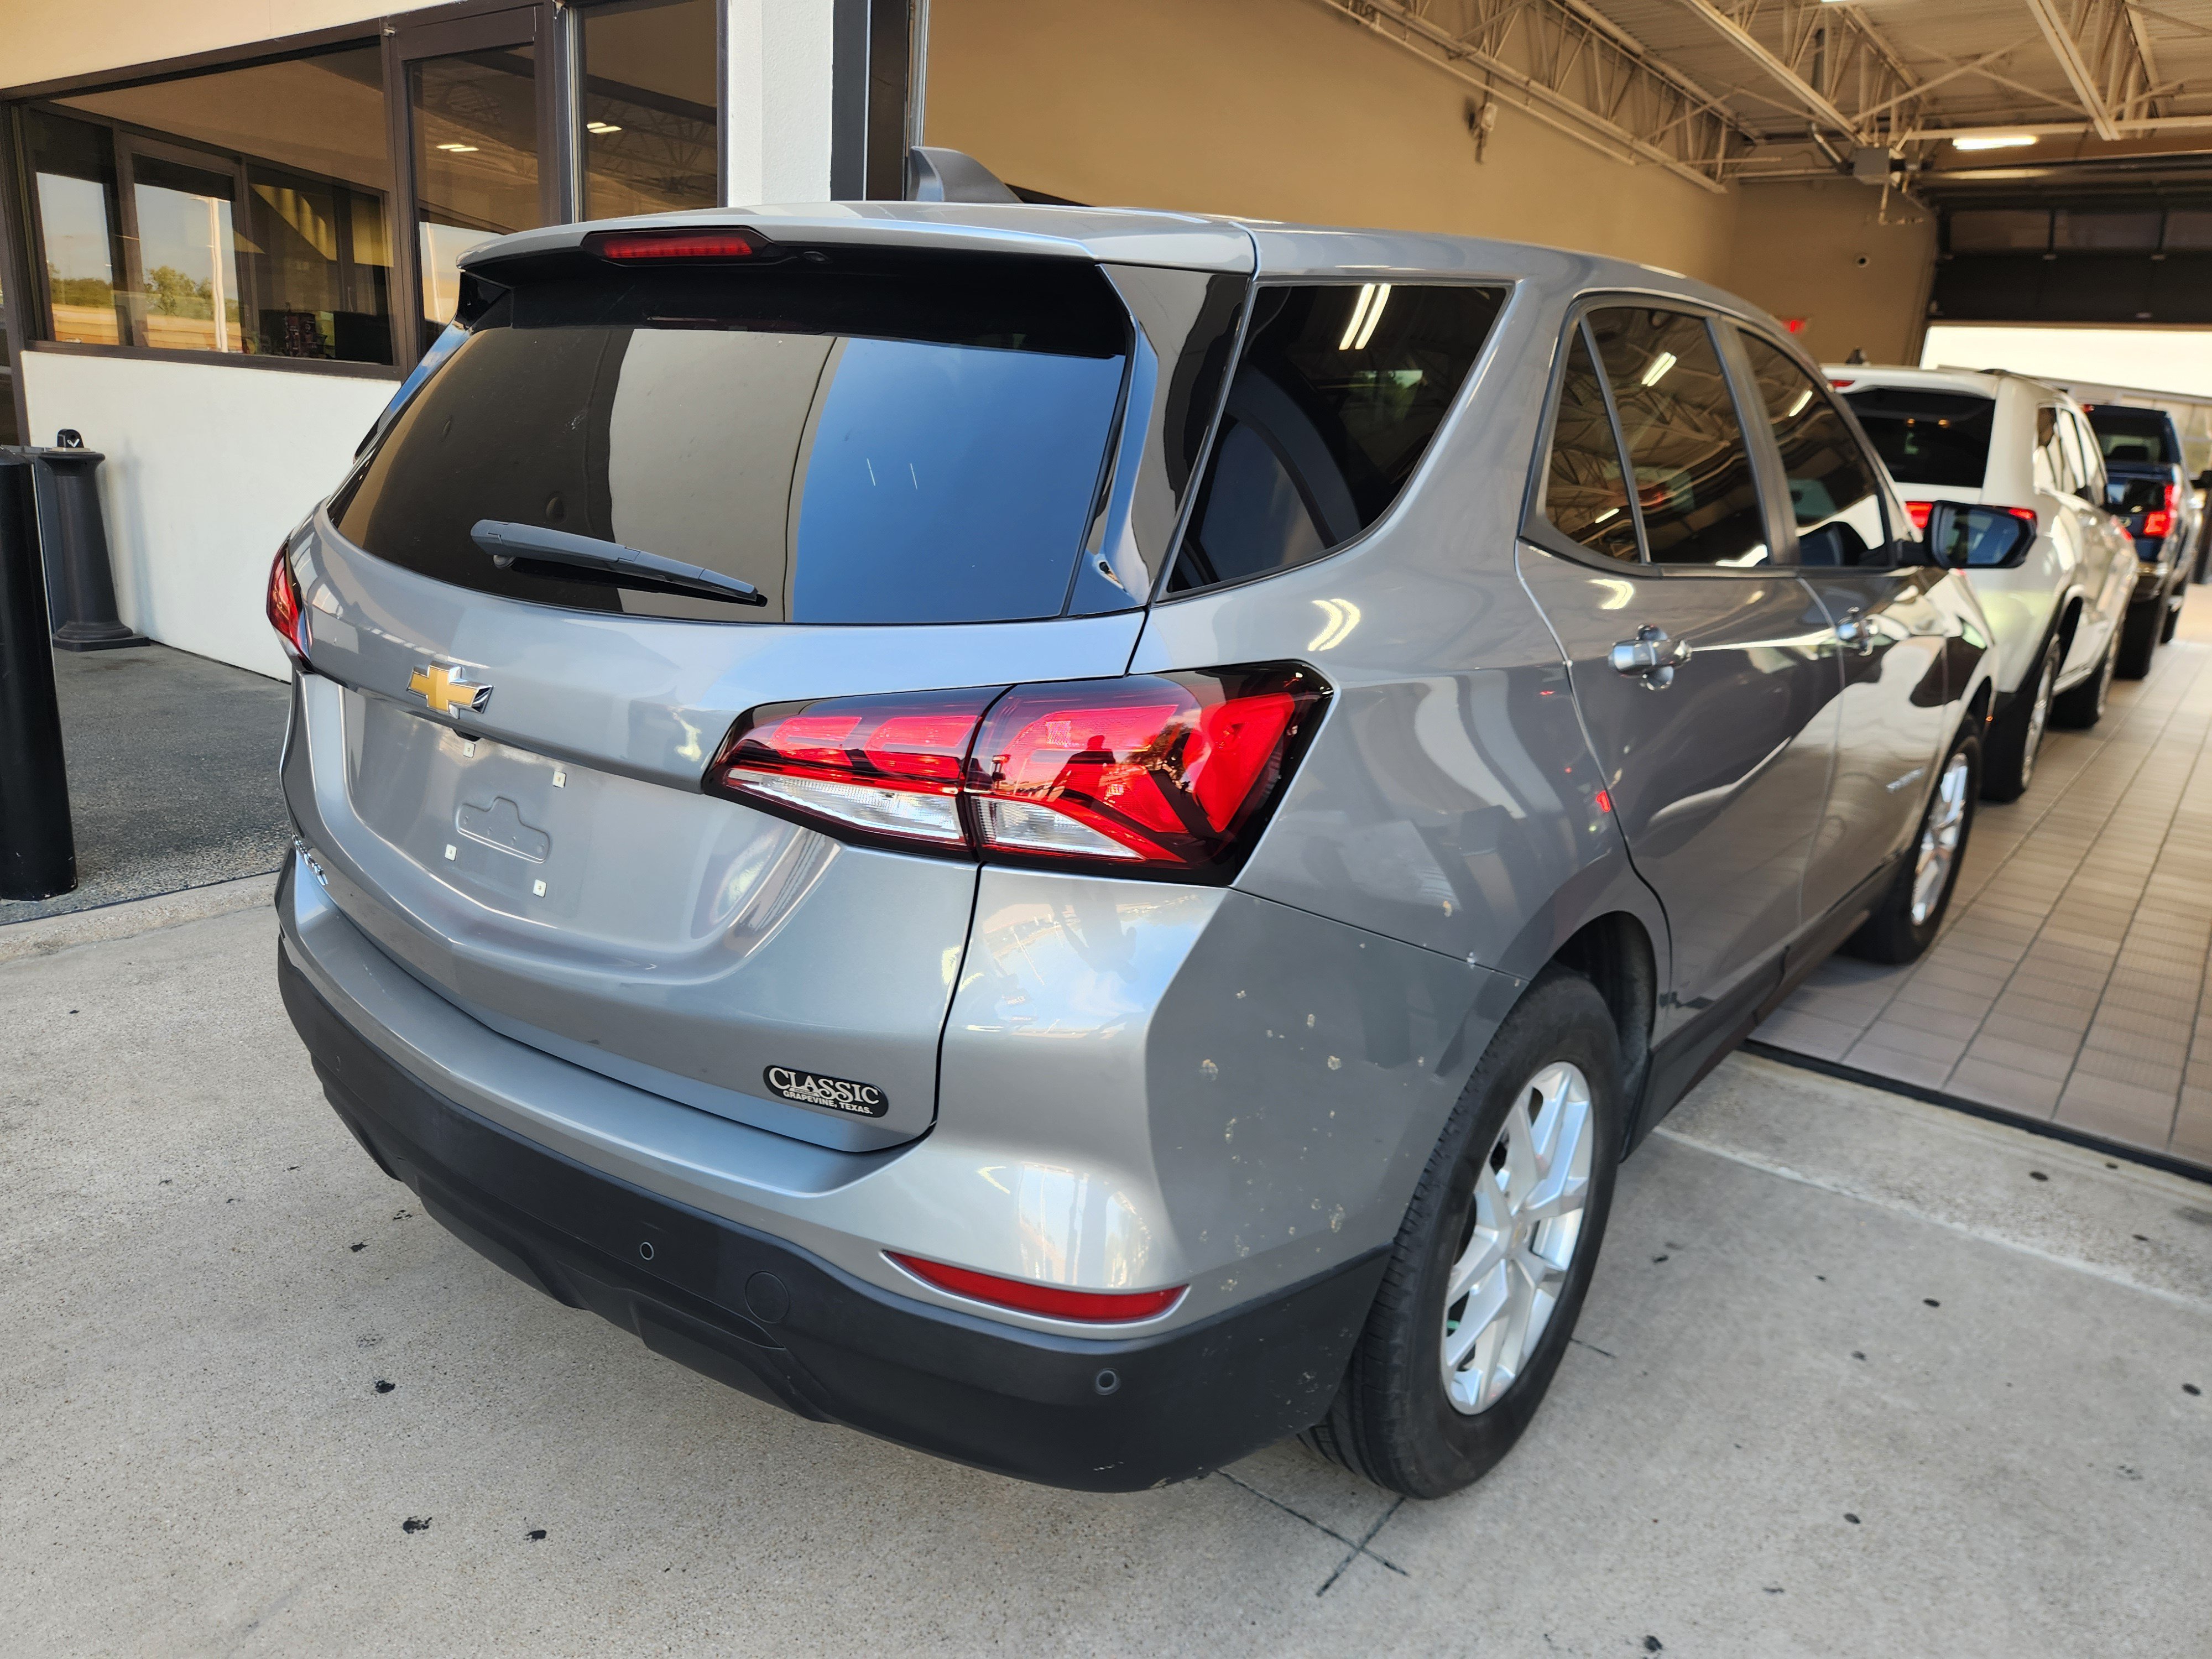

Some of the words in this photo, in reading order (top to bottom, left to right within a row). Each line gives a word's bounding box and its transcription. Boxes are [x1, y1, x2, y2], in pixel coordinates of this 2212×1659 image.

[769, 1067, 879, 1104] CLASSIC
[783, 1091, 838, 1108] GRAPEVINE,
[839, 1102, 873, 1114] TEXAS.
